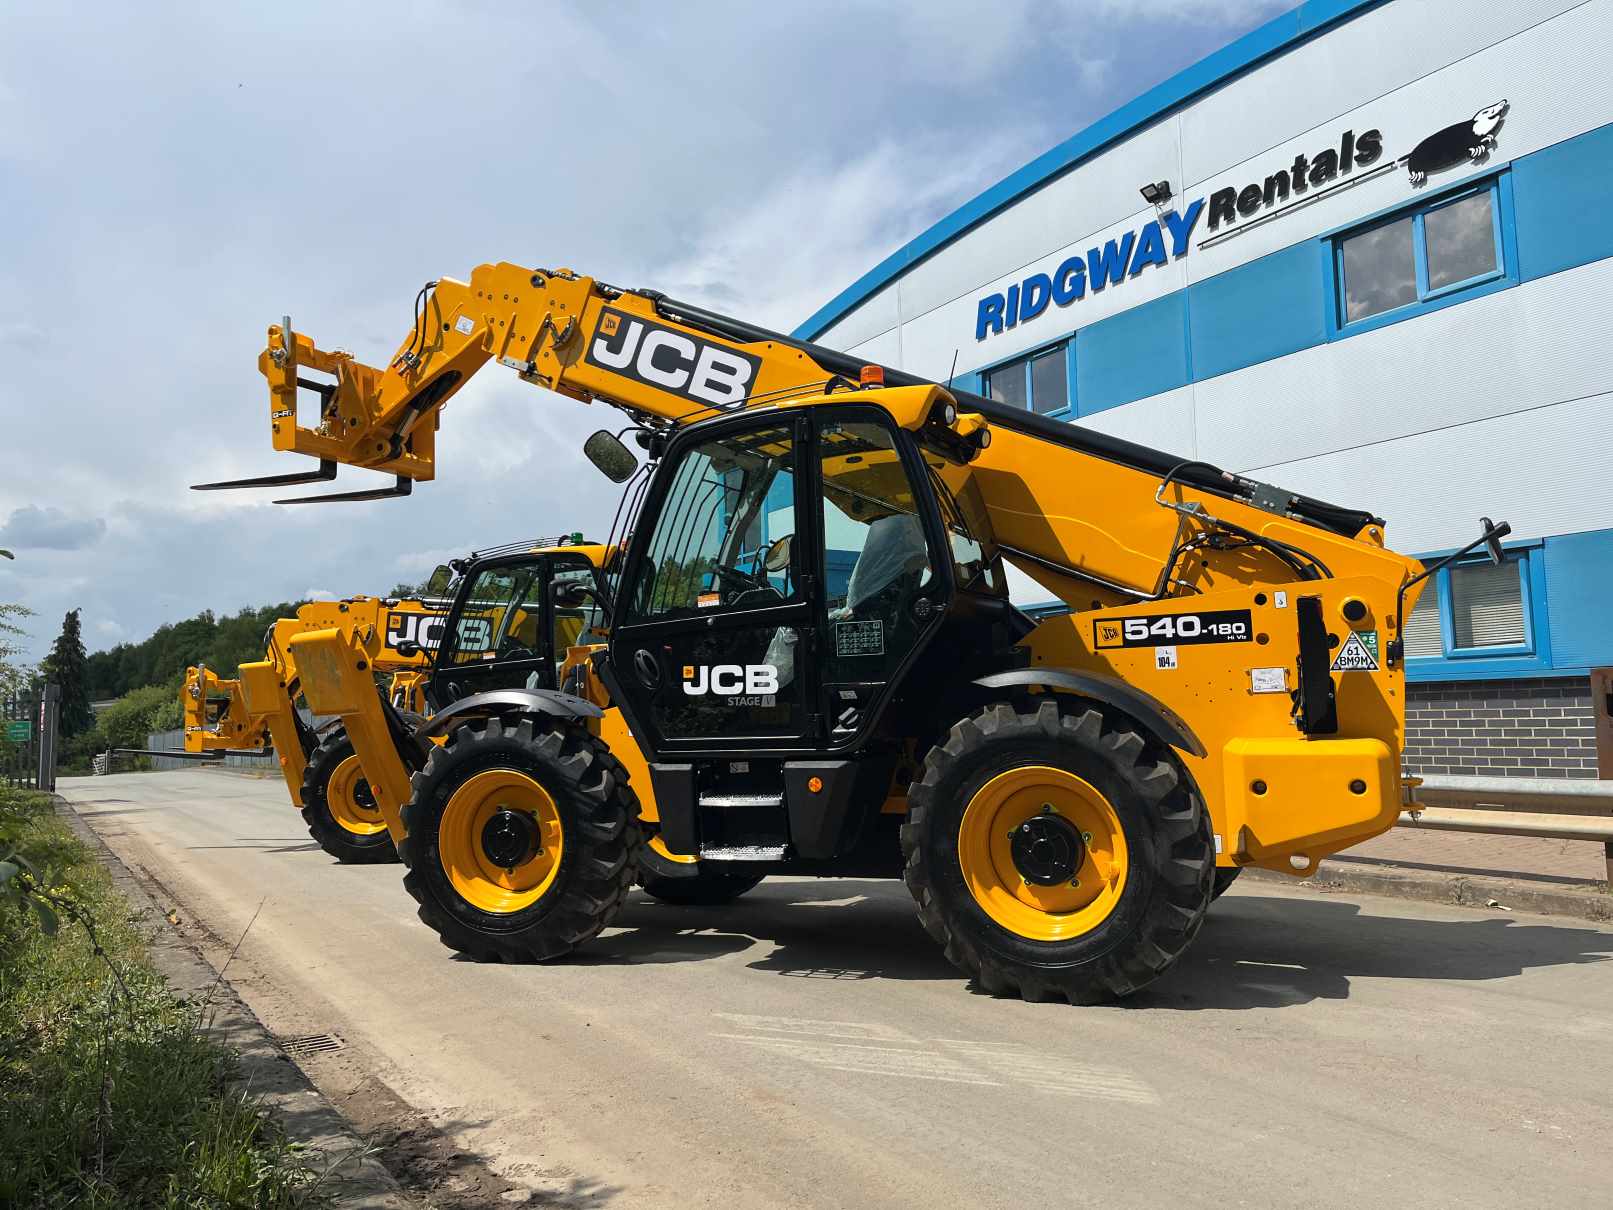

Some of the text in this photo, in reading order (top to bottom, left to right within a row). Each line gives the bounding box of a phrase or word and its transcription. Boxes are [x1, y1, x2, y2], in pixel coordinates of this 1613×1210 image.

[975, 128, 1382, 340] RIDGWAY Rentals
[593, 320, 752, 409] JCB
[1346, 646, 1361, 656] 61
[1157, 656, 1171, 668] 104
[1339, 656, 1369, 666] BM9M
[682, 664, 779, 695] JCB
[727, 696, 761, 706] STAGE
